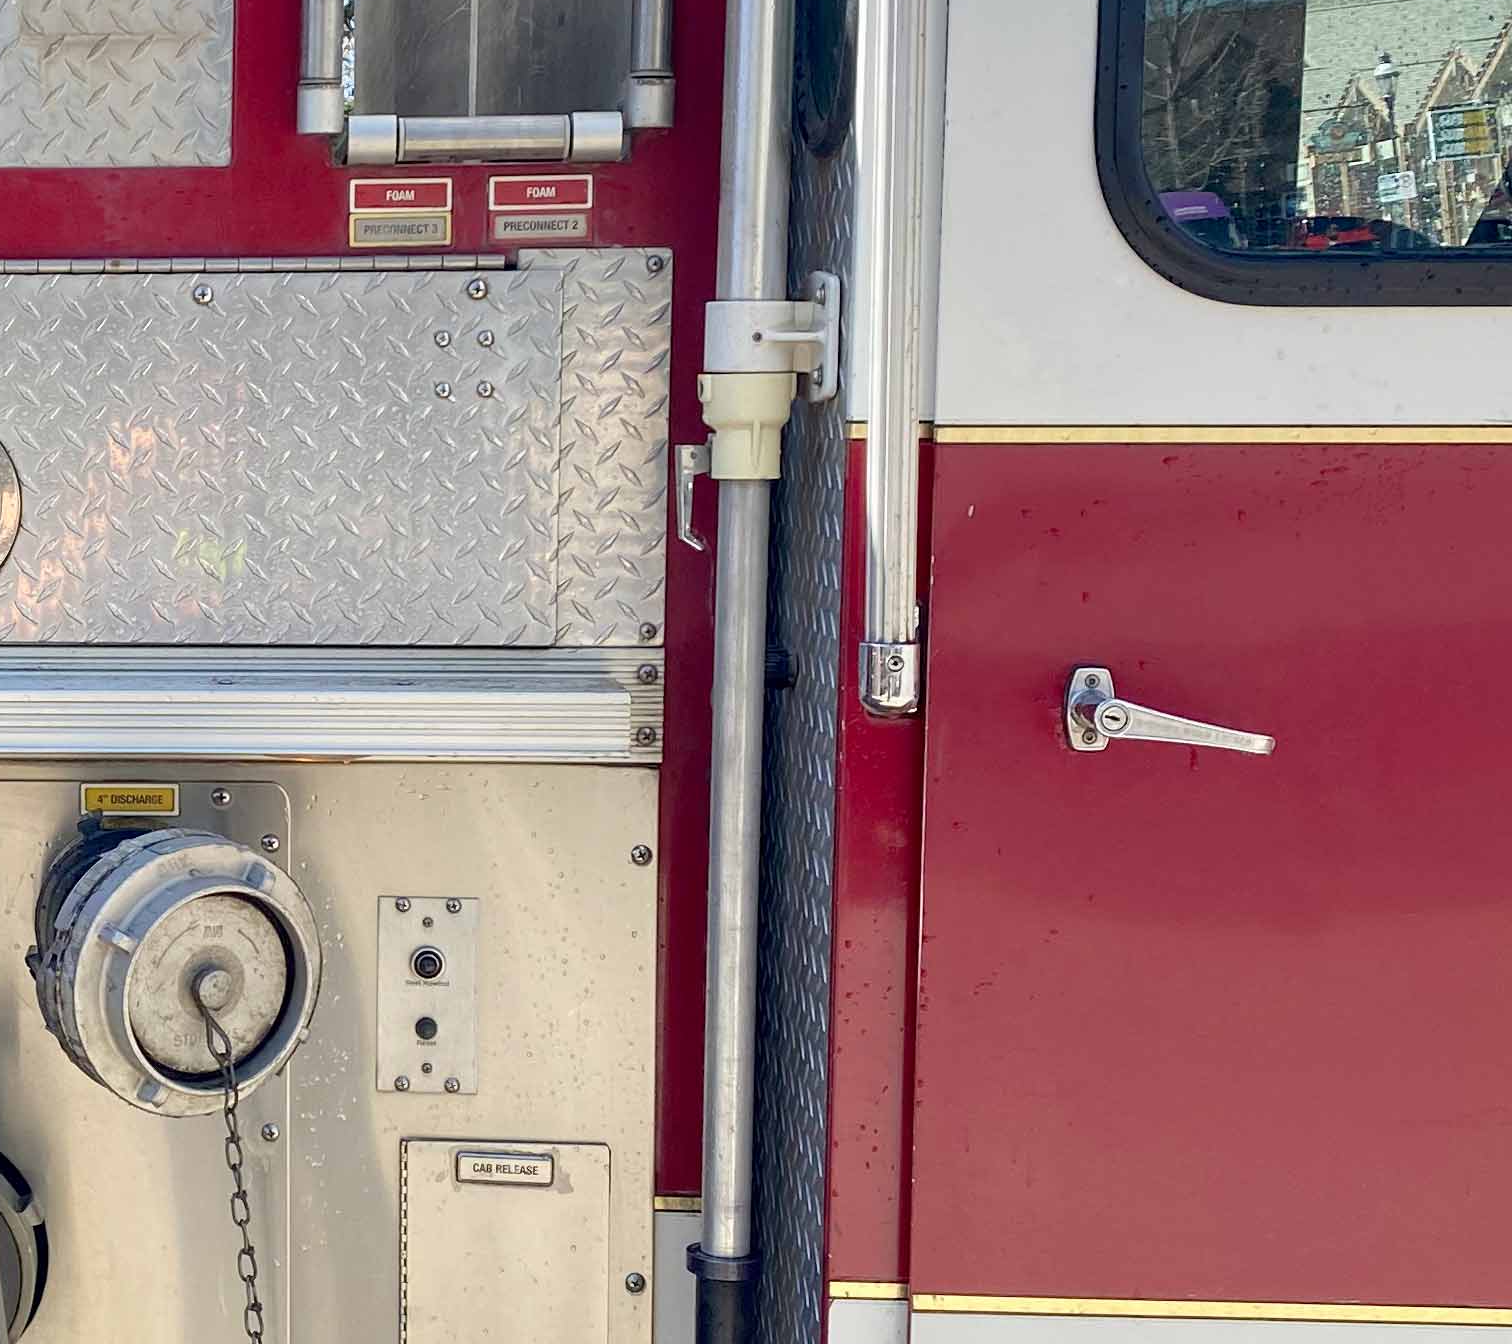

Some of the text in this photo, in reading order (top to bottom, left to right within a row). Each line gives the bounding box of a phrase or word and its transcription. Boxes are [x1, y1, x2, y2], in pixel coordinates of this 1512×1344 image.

[386, 190, 415, 201] FOAM
[526, 186, 556, 198] FOAM
[363, 223, 429, 235] PRECONNECT
[503, 220, 579, 232] PRECONNECT 2
[111, 794, 163, 805] DISCHARGE
[473, 1163, 539, 1176] CAB RELEASE
